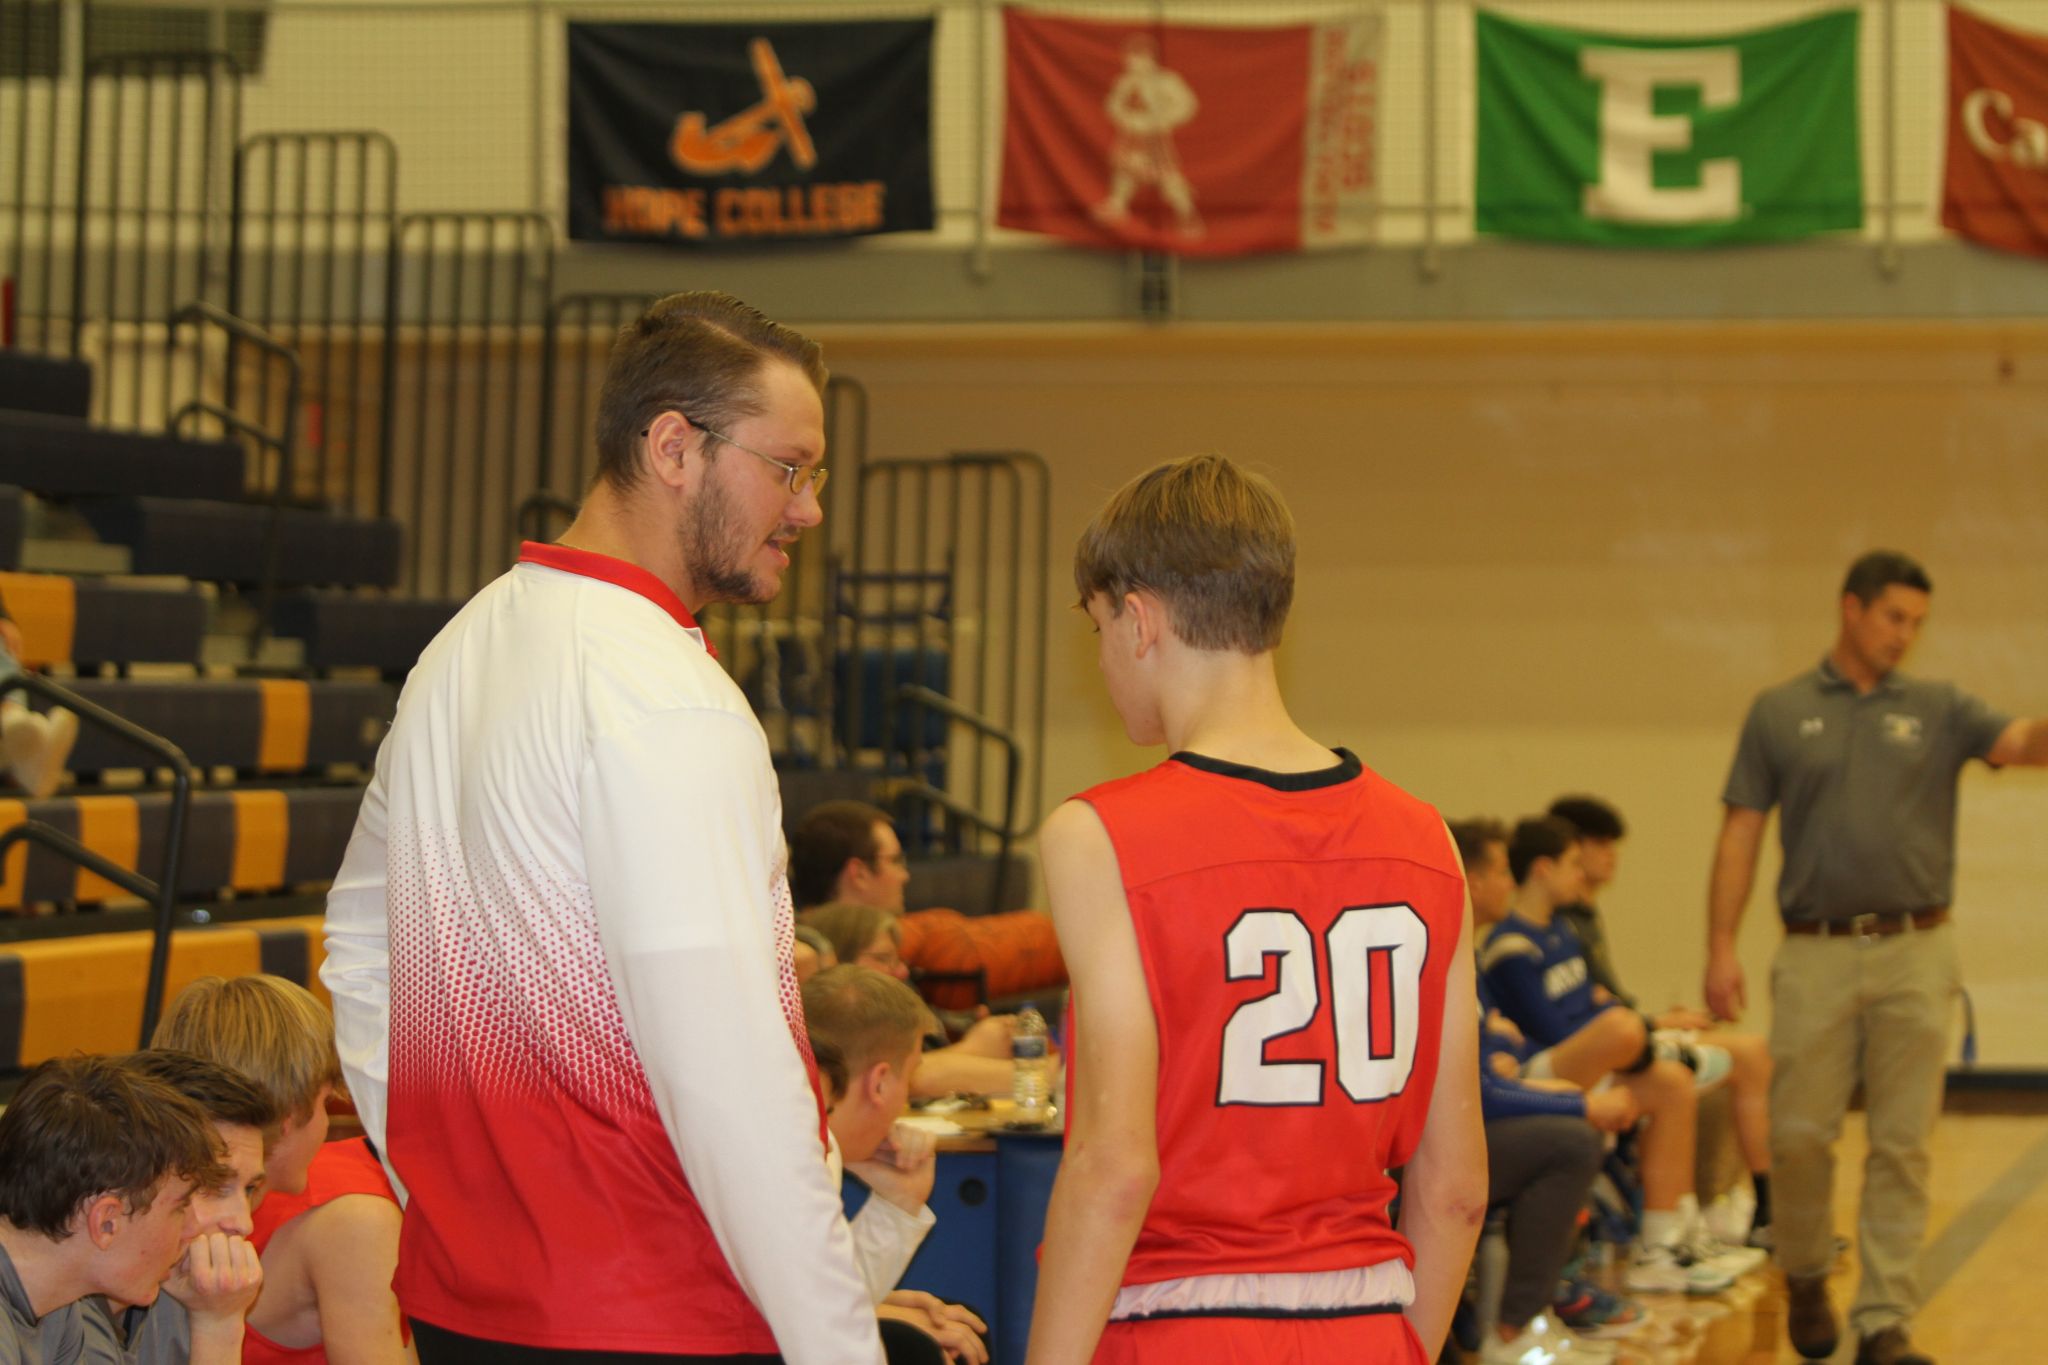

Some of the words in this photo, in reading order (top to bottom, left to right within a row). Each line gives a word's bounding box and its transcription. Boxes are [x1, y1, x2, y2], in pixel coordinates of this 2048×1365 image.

[714, 181, 886, 237] COLLEGE
[1581, 48, 1740, 225] E
[1215, 902, 1429, 1107] 20
